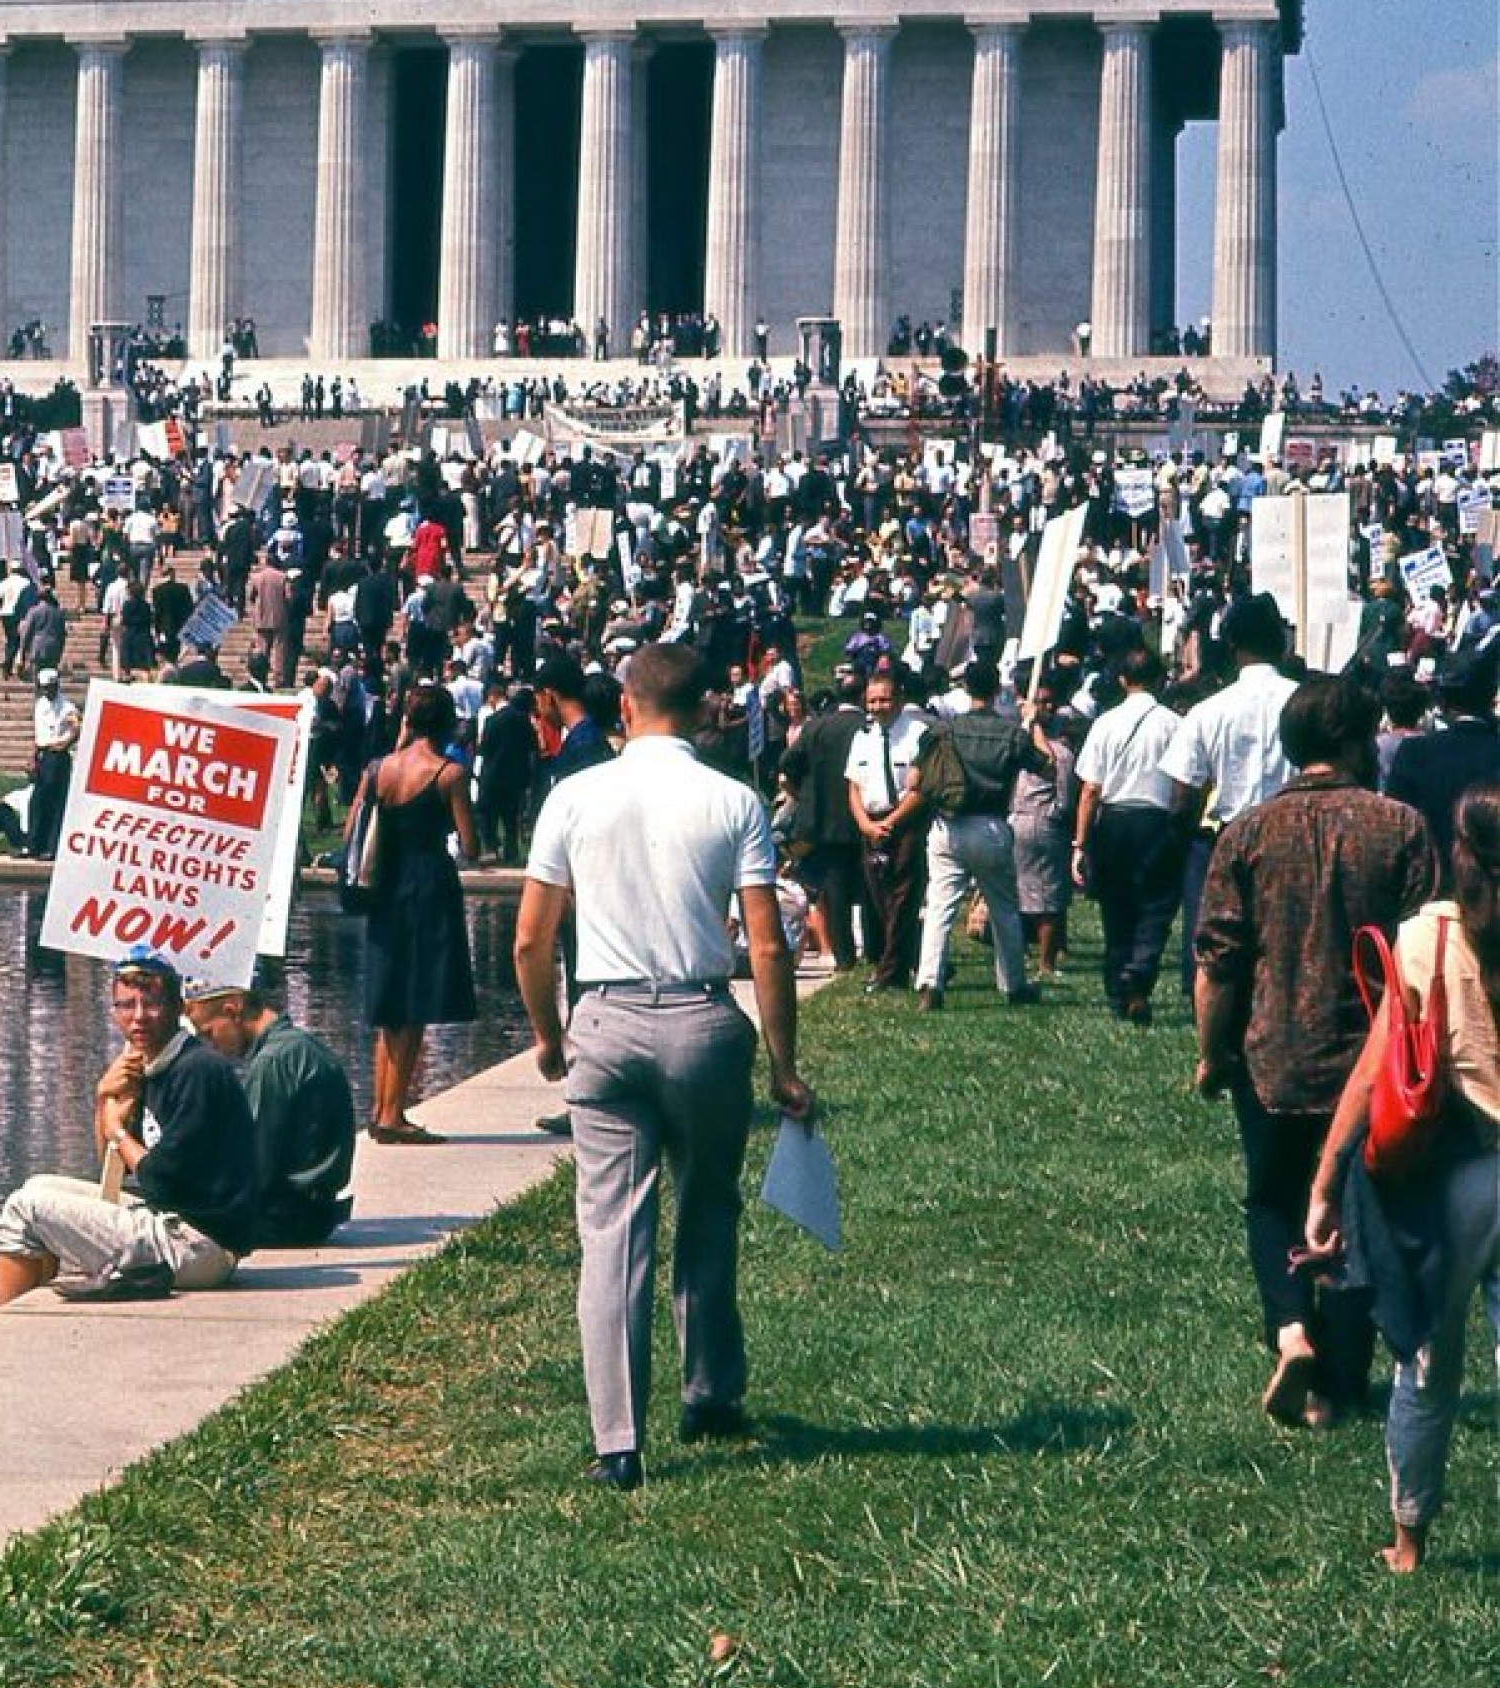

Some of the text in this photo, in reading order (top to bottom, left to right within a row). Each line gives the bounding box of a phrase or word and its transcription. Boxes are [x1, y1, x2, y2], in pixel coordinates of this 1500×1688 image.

[162, 720, 216, 753] WE
[104, 741, 258, 801] MARCH
[147, 785, 207, 812] FOR
[94, 810, 251, 861] EFFECTIVE
[67, 832, 257, 891] CIVIL RIGHTS
[112, 871, 199, 907] LAWS
[70, 896, 236, 959] NOW!
